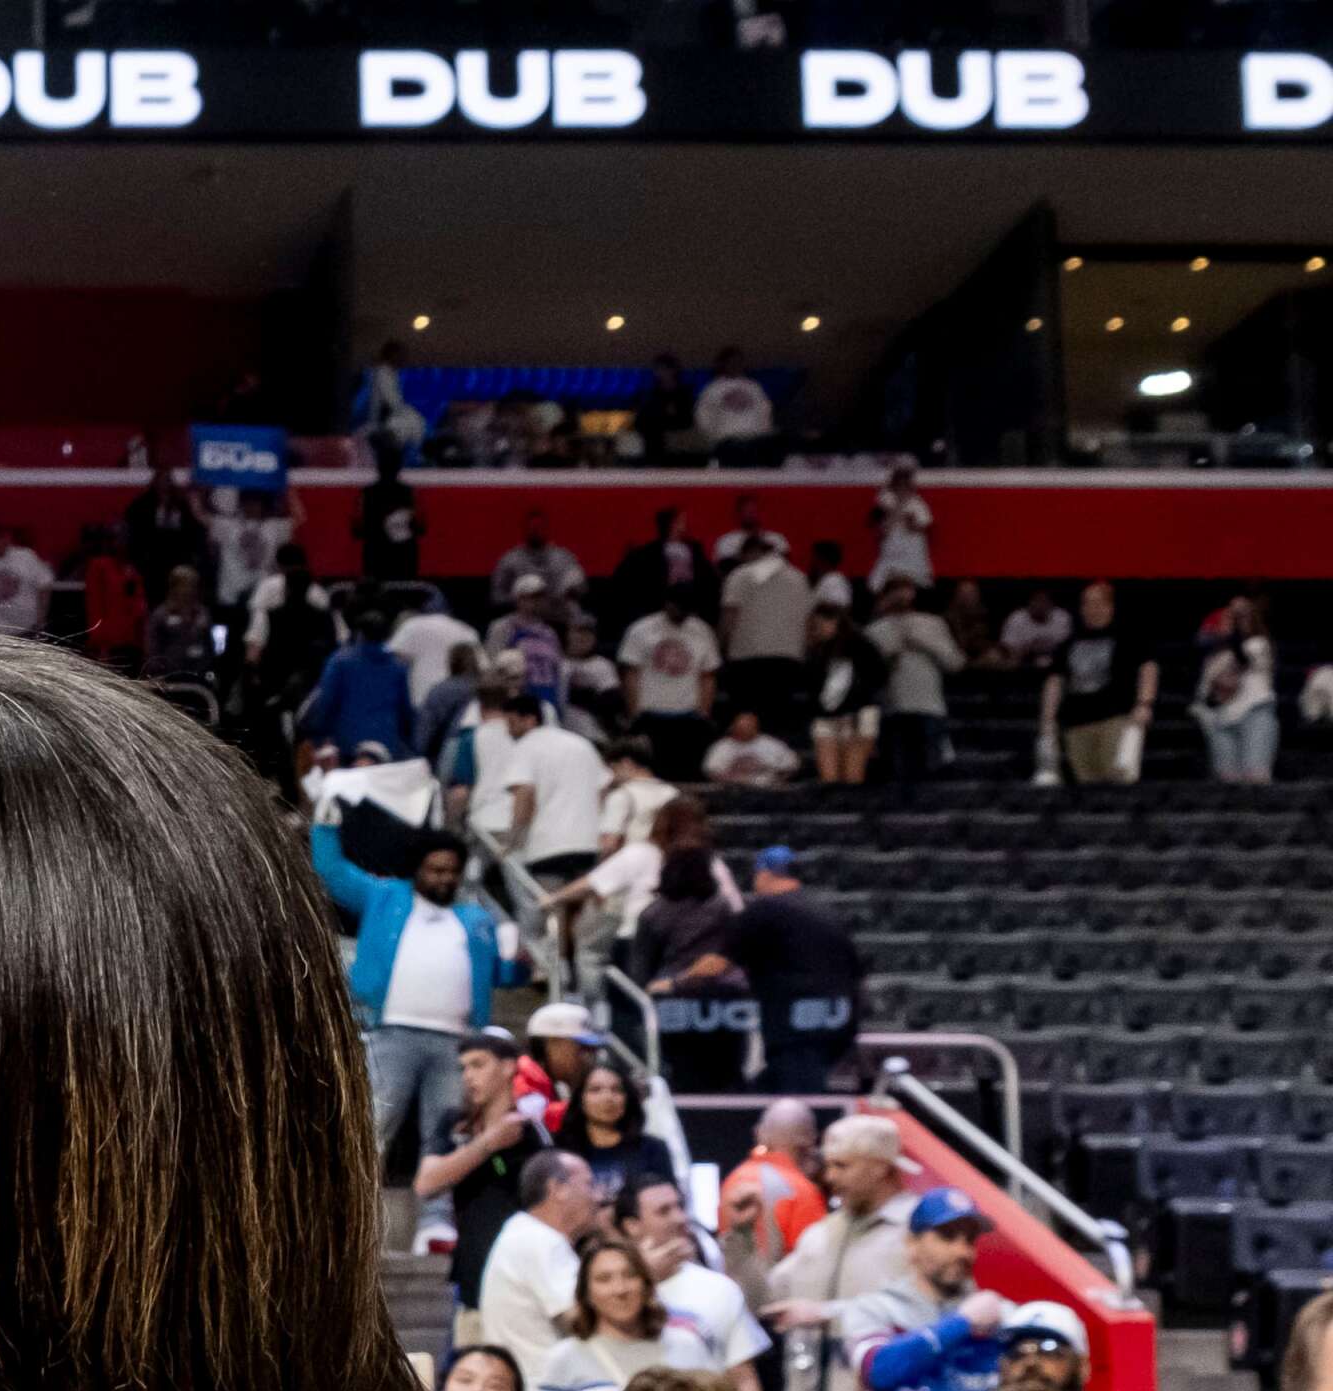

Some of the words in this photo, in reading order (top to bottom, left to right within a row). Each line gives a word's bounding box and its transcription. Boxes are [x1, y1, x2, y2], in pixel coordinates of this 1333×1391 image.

[359, 49, 647, 129] DUB
[801, 50, 1090, 130] DUB
[1241, 52, 1333, 130] D
